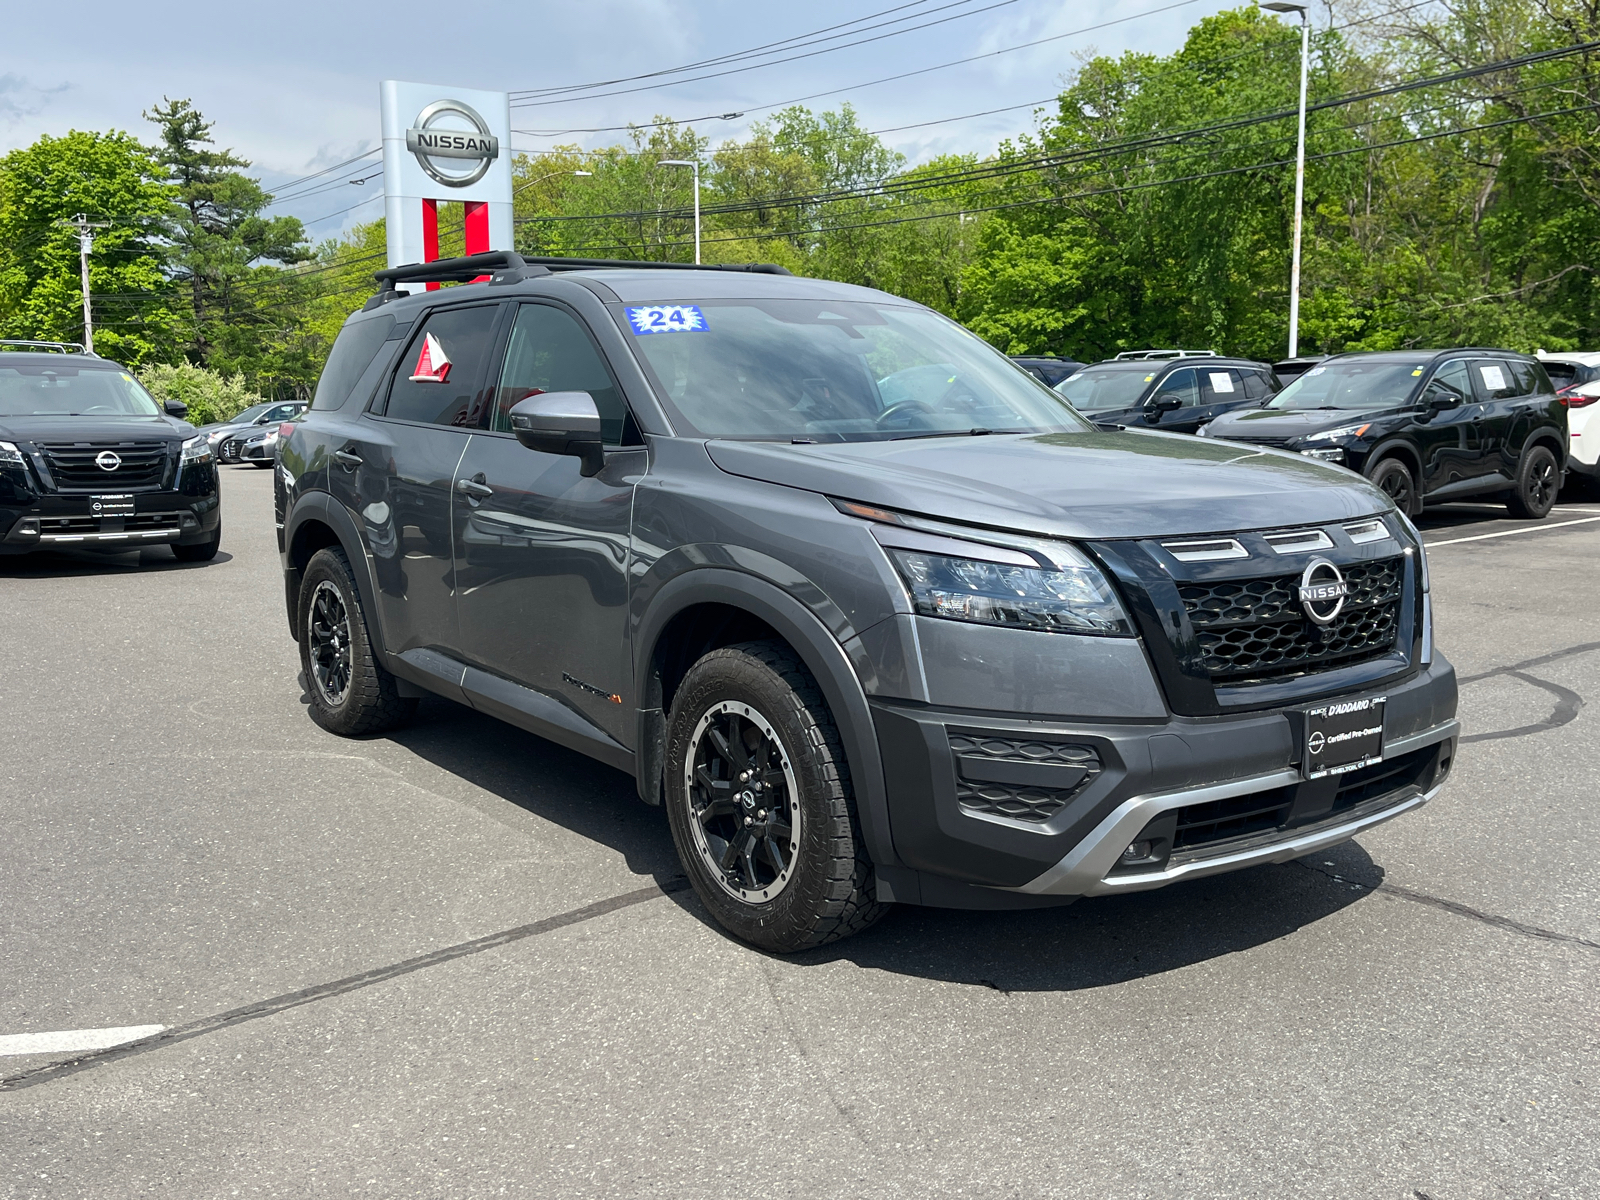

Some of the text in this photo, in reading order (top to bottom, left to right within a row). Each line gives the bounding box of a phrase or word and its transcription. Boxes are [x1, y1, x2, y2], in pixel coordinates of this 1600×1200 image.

[417, 133, 491, 152] NISSAN
[648, 310, 686, 326] 24
[1301, 583, 1347, 600] NISSAN
[1328, 699, 1370, 717] D'ADDARIO
[1327, 724, 1383, 744] Certified Pre-Owned
[1357, 761, 1365, 769] CT
